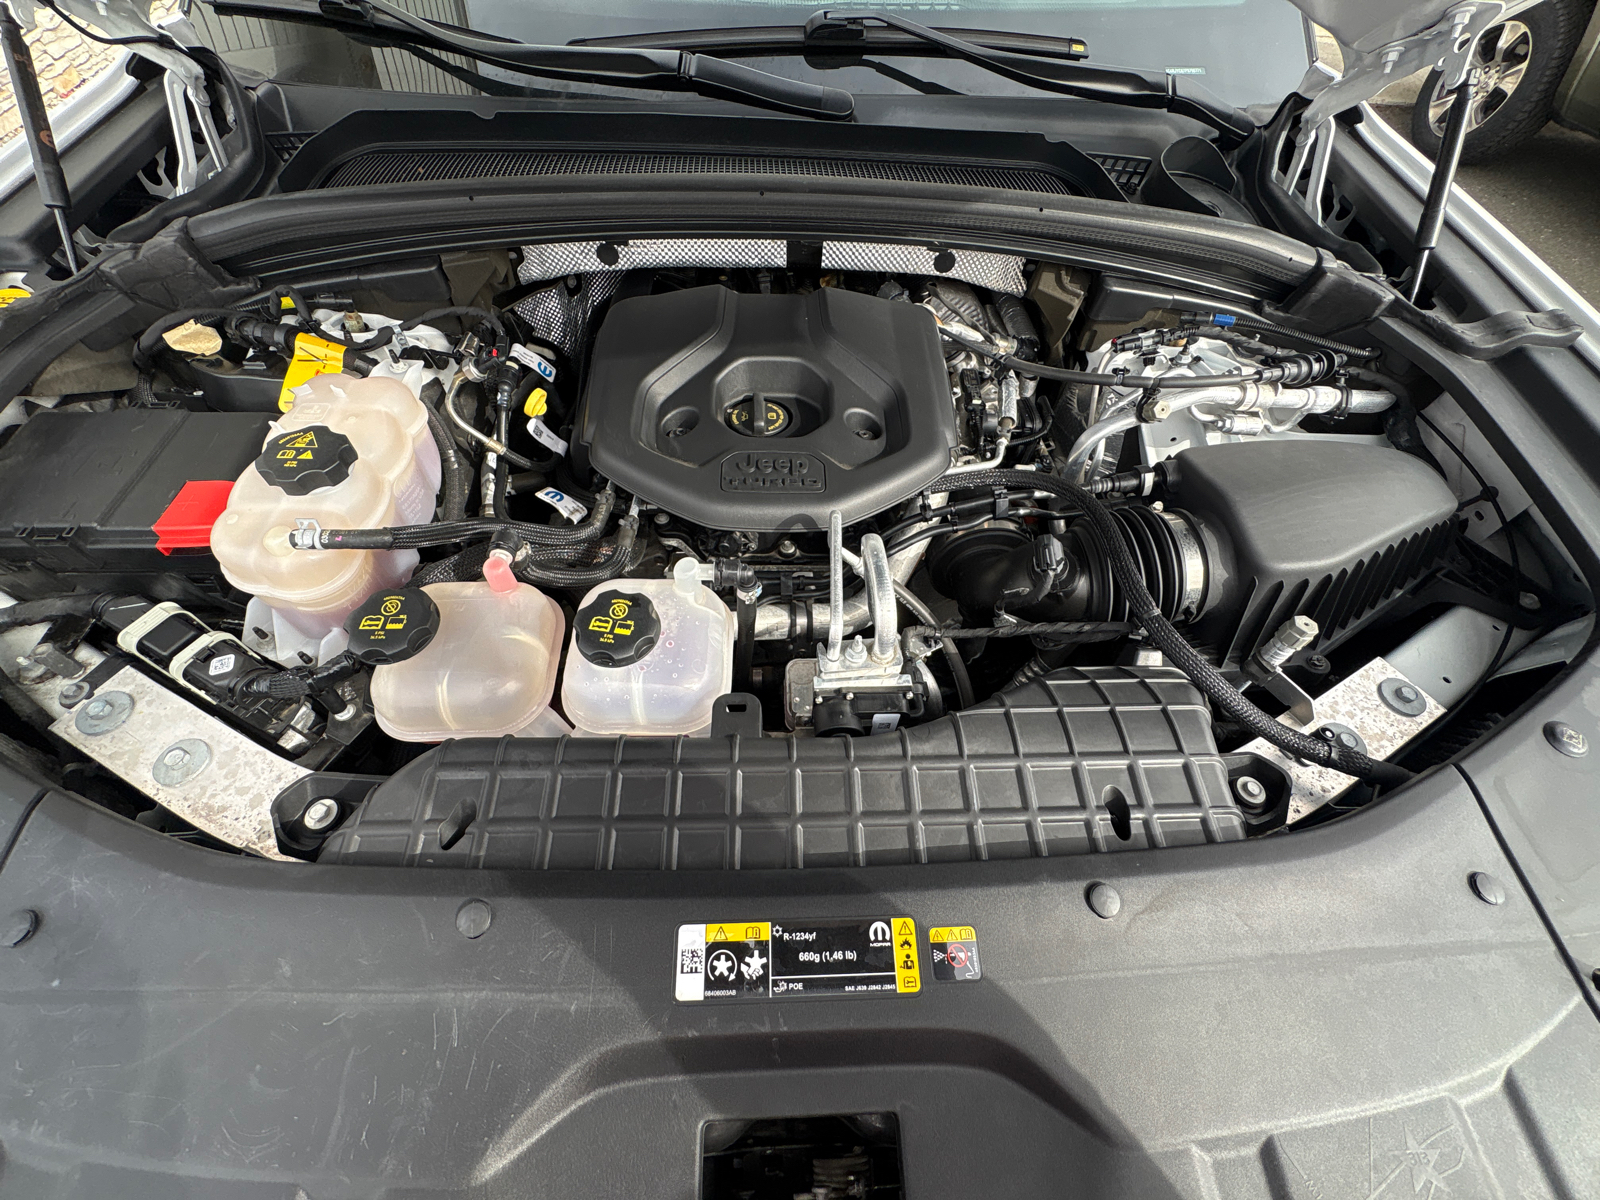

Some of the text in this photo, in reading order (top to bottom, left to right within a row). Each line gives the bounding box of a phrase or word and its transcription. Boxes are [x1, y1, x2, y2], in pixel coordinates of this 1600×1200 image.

[735, 454, 807, 476] Jeep
[783, 931, 816, 941] R-1234yf
[798, 951, 820, 962] 660g
[845, 950, 857, 962] lb)
